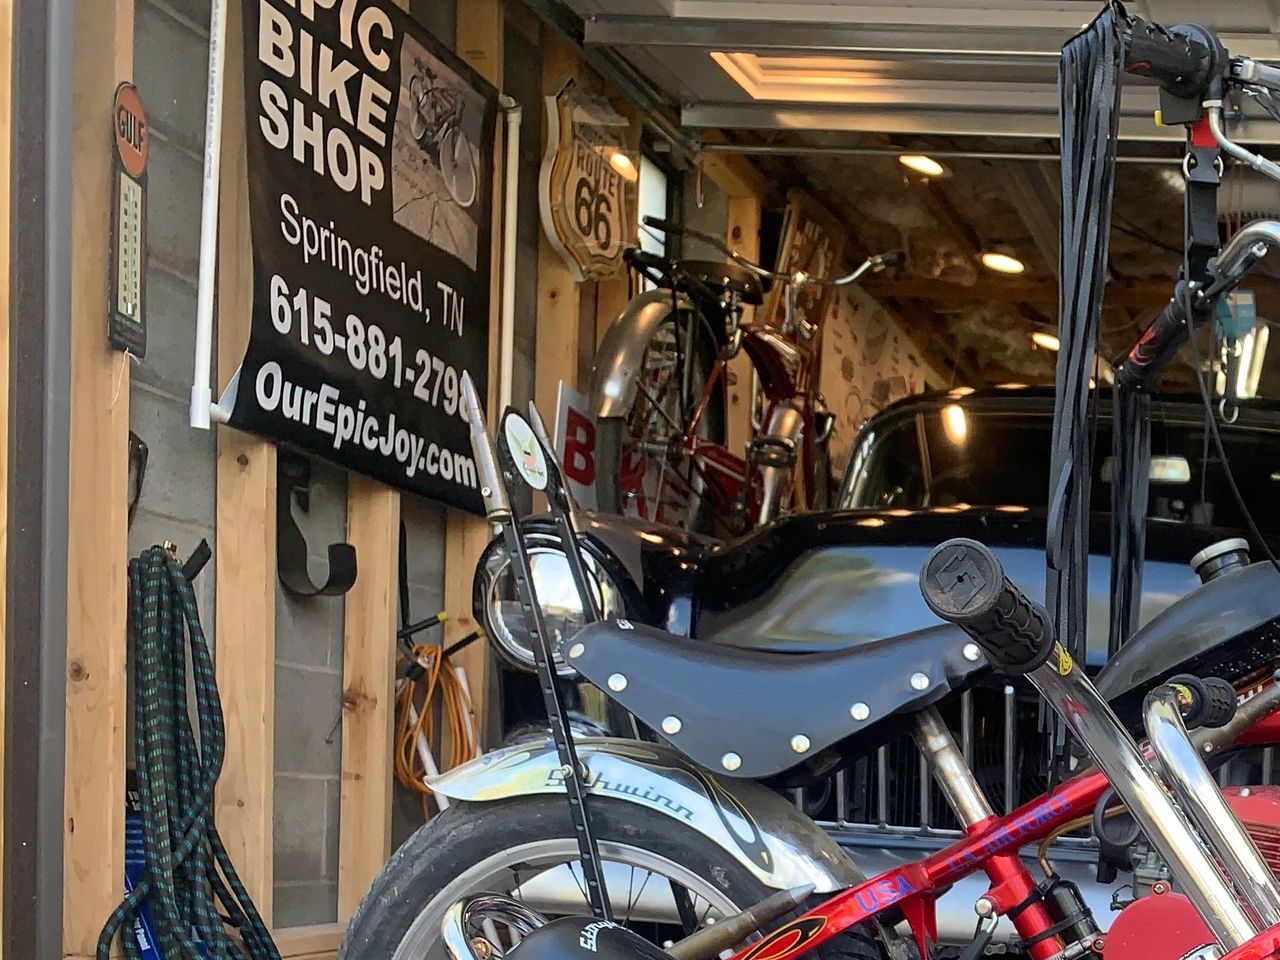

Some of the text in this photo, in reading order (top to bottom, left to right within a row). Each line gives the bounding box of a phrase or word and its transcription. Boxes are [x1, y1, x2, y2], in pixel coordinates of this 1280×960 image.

[258, 1, 392, 147] BIKE
[117, 103, 145, 156] GULF
[259, 80, 385, 206] SHOP
[576, 145, 617, 197] ROUTE
[575, 177, 612, 251] 66
[280, 193, 464, 336] Springfield, TN
[256, 361, 477, 488] OurEpicJoy.com
[545, 768, 695, 821] Shwinn
[855, 875, 917, 912] USA
